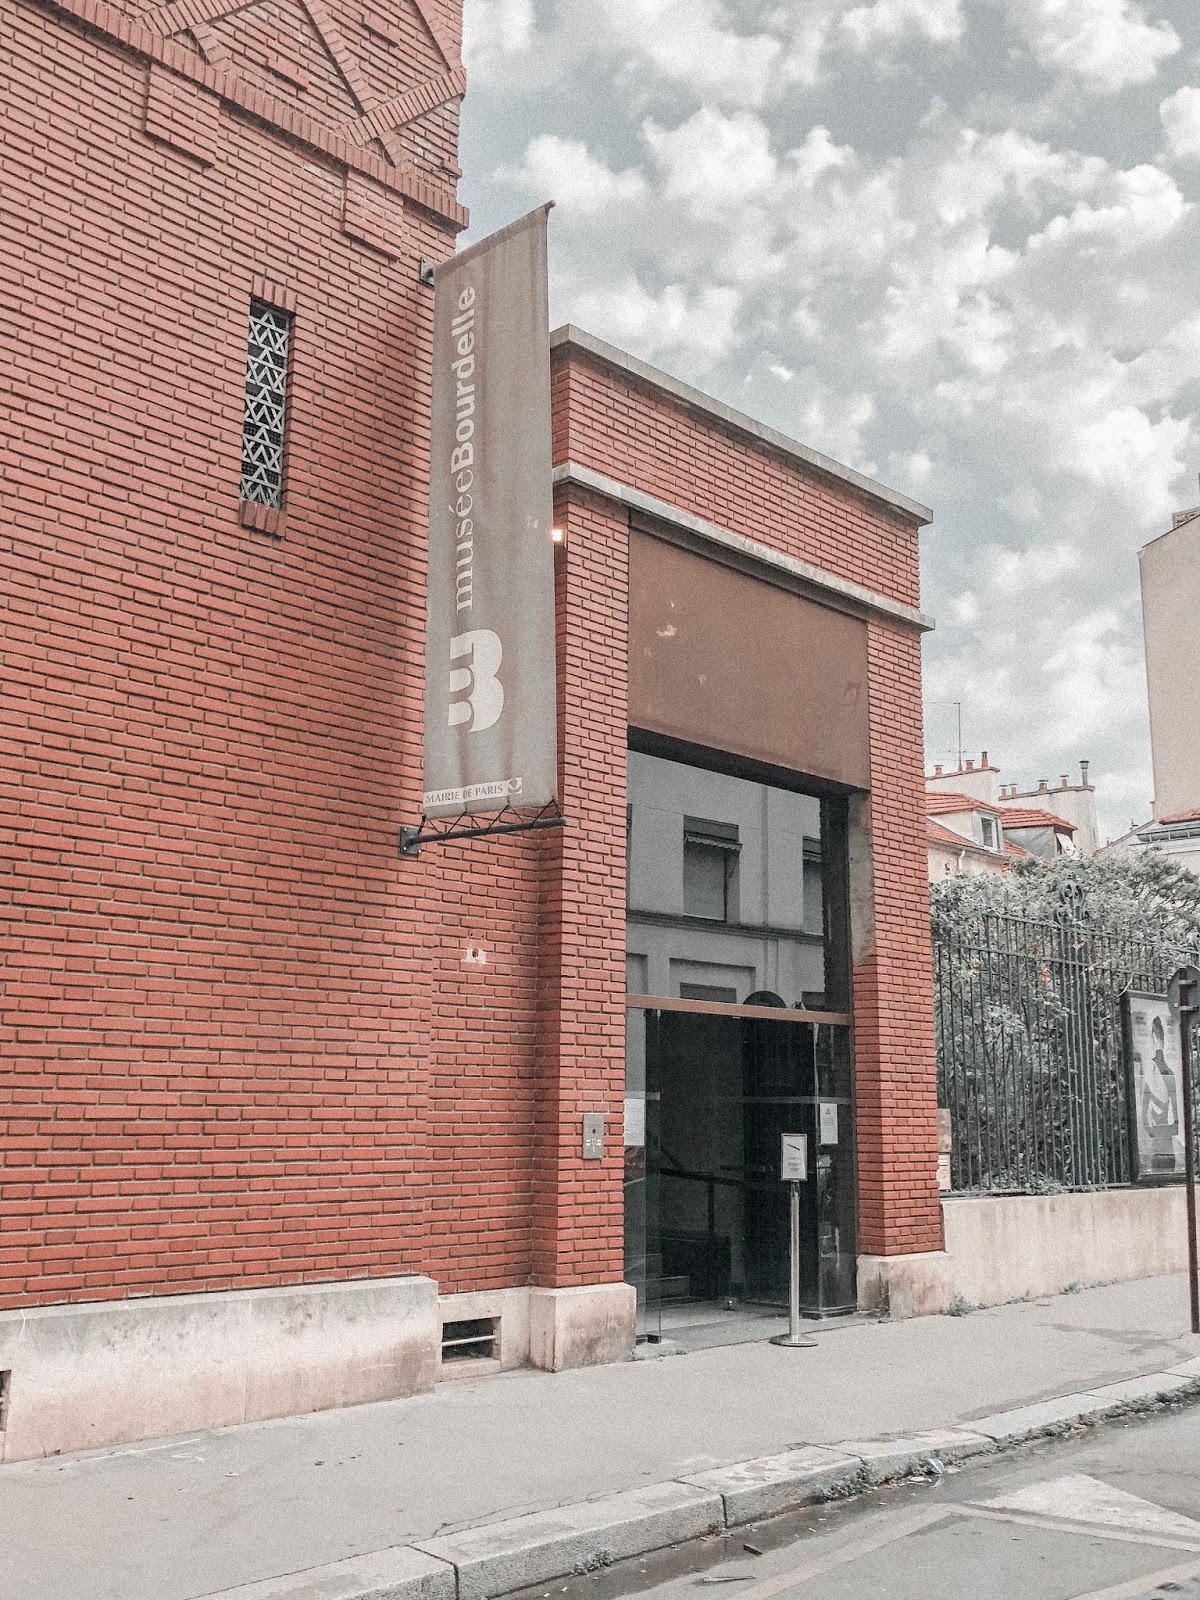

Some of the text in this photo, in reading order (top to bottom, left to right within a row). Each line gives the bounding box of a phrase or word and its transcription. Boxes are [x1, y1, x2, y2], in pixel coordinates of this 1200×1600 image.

[425, 784, 503, 804] MAIRIE DE PARIS
